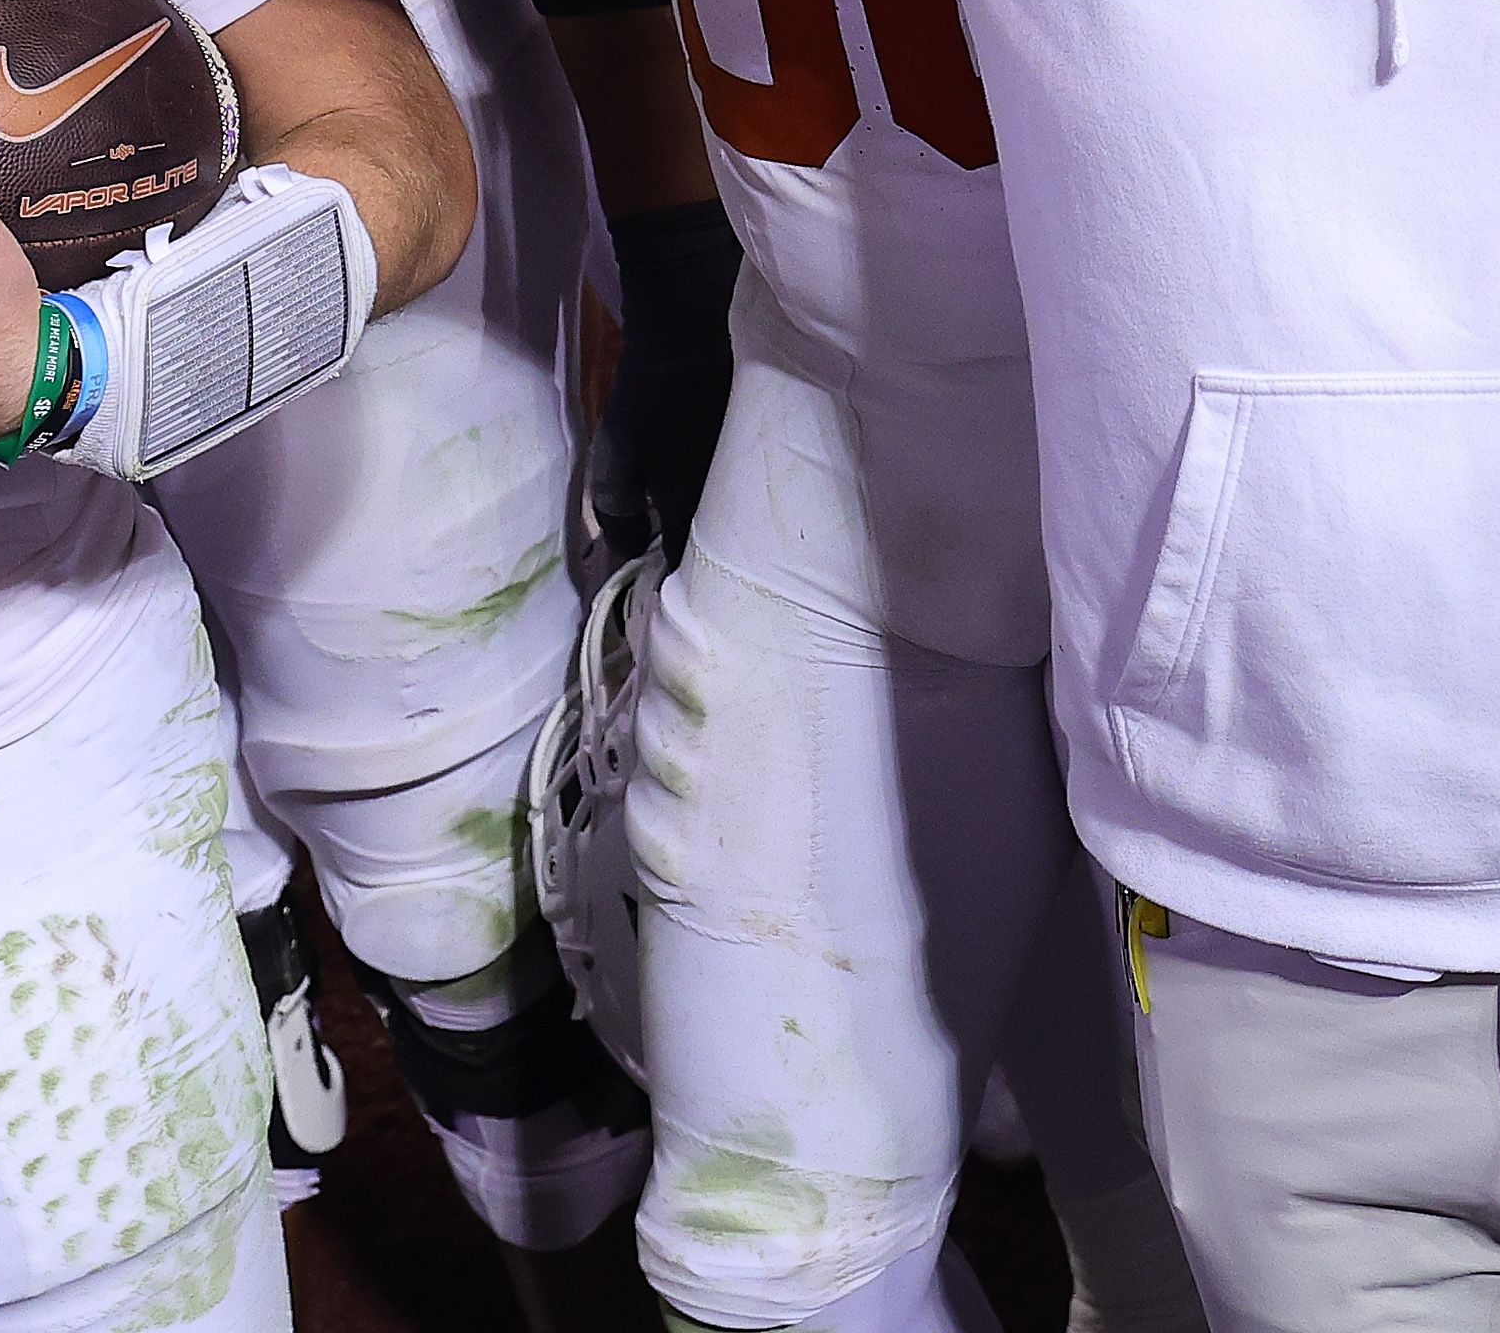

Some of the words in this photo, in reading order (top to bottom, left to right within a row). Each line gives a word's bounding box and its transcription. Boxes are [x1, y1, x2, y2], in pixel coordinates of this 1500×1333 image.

[18, 183, 129, 218] VAPOR
[132, 158, 198, 201] ELITE
[48, 326, 60, 357] MEAN
[44, 355, 58, 383] MORE
